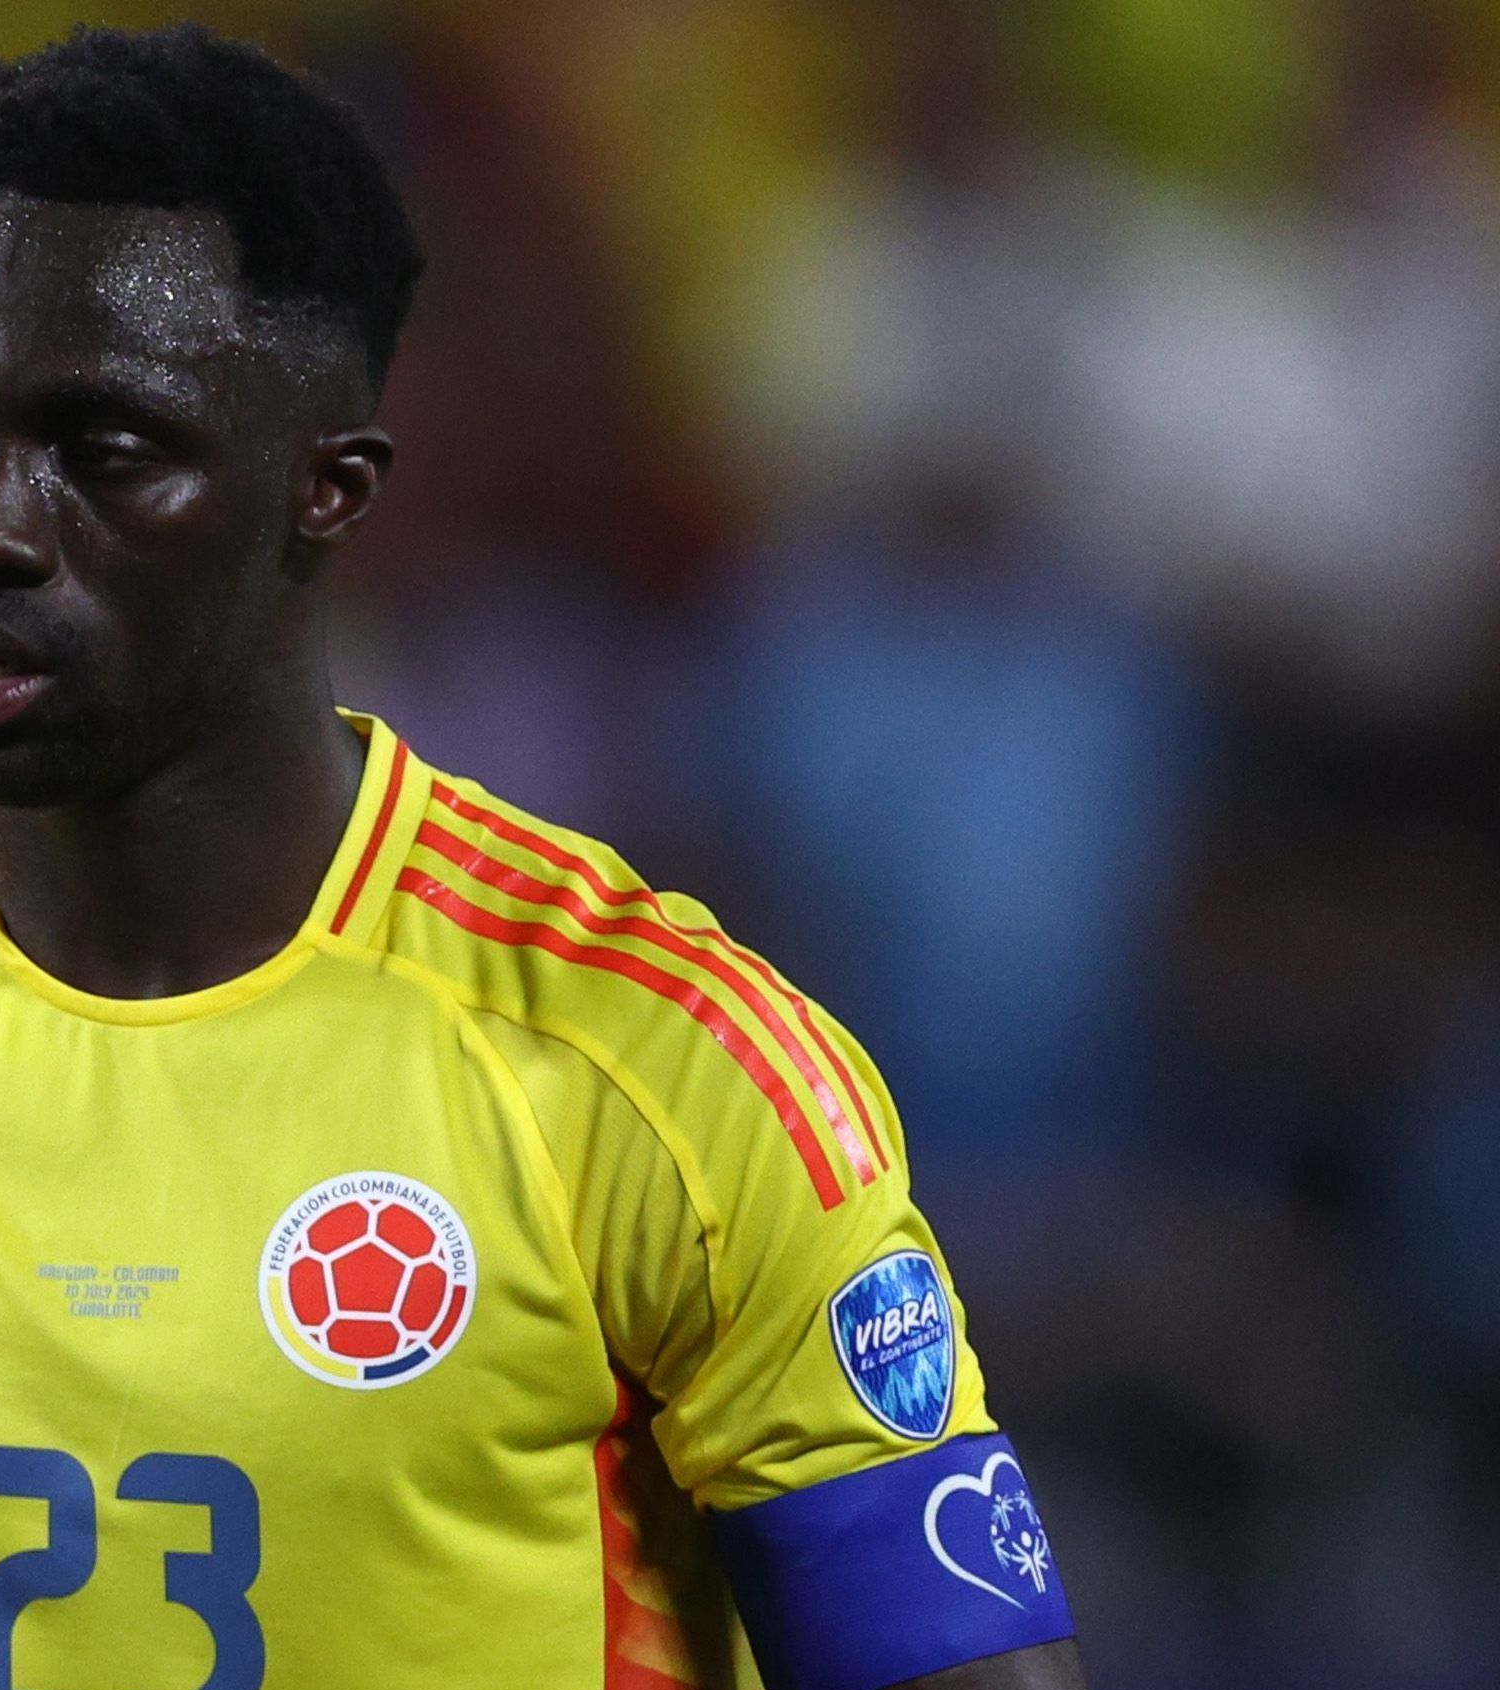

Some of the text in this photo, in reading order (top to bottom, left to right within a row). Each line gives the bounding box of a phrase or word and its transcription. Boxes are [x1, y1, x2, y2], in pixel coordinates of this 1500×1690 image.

[331, 1179, 429, 1210] COLOMBIANA
[428, 1205, 448, 1224] DE
[441, 1221, 467, 1279] FUTBOL
[113, 1265, 180, 1283] COLOMBIA
[65, 1284, 150, 1300] 10 JULY 2024
[69, 1302, 142, 1319] CHARLOTTE
[855, 1291, 939, 1356] VIBRA
[861, 1325, 942, 1371] EL CONTINENTE
